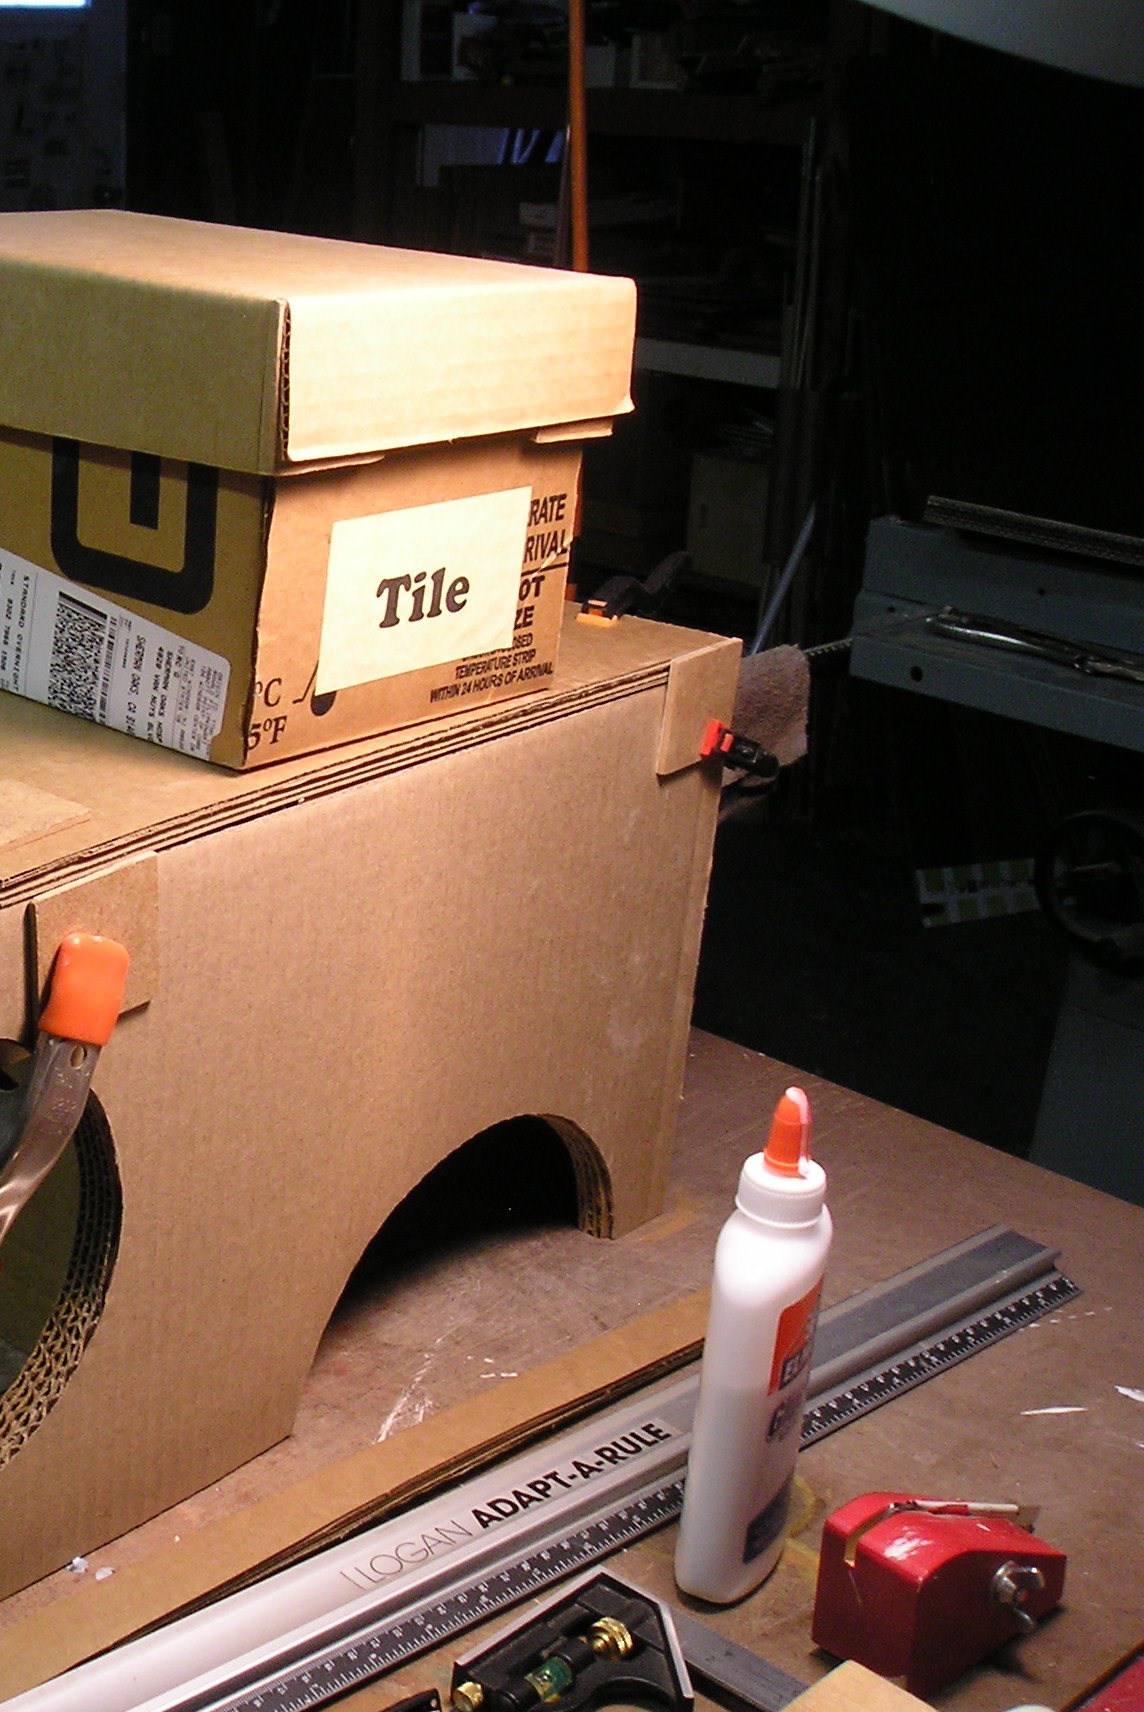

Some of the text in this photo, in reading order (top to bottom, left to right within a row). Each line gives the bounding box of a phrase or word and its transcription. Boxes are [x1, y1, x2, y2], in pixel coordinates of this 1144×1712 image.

[376, 567, 470, 629] Tile
[13, 575, 30, 691] STANDARD OVERNIGHT
[133, 635, 146, 672] SHERMAN
[163, 651, 173, 690] SHERMAN
[455, 656, 512, 680] TEMPERATURE
[513, 648, 536, 666] STRIP
[430, 662, 553, 703] WITHIN 24 HOURS OF ARRIVAL
[159, 694, 167, 717] OAKS
[470, 1422, 672, 1529] ADAPT-A-RULE
